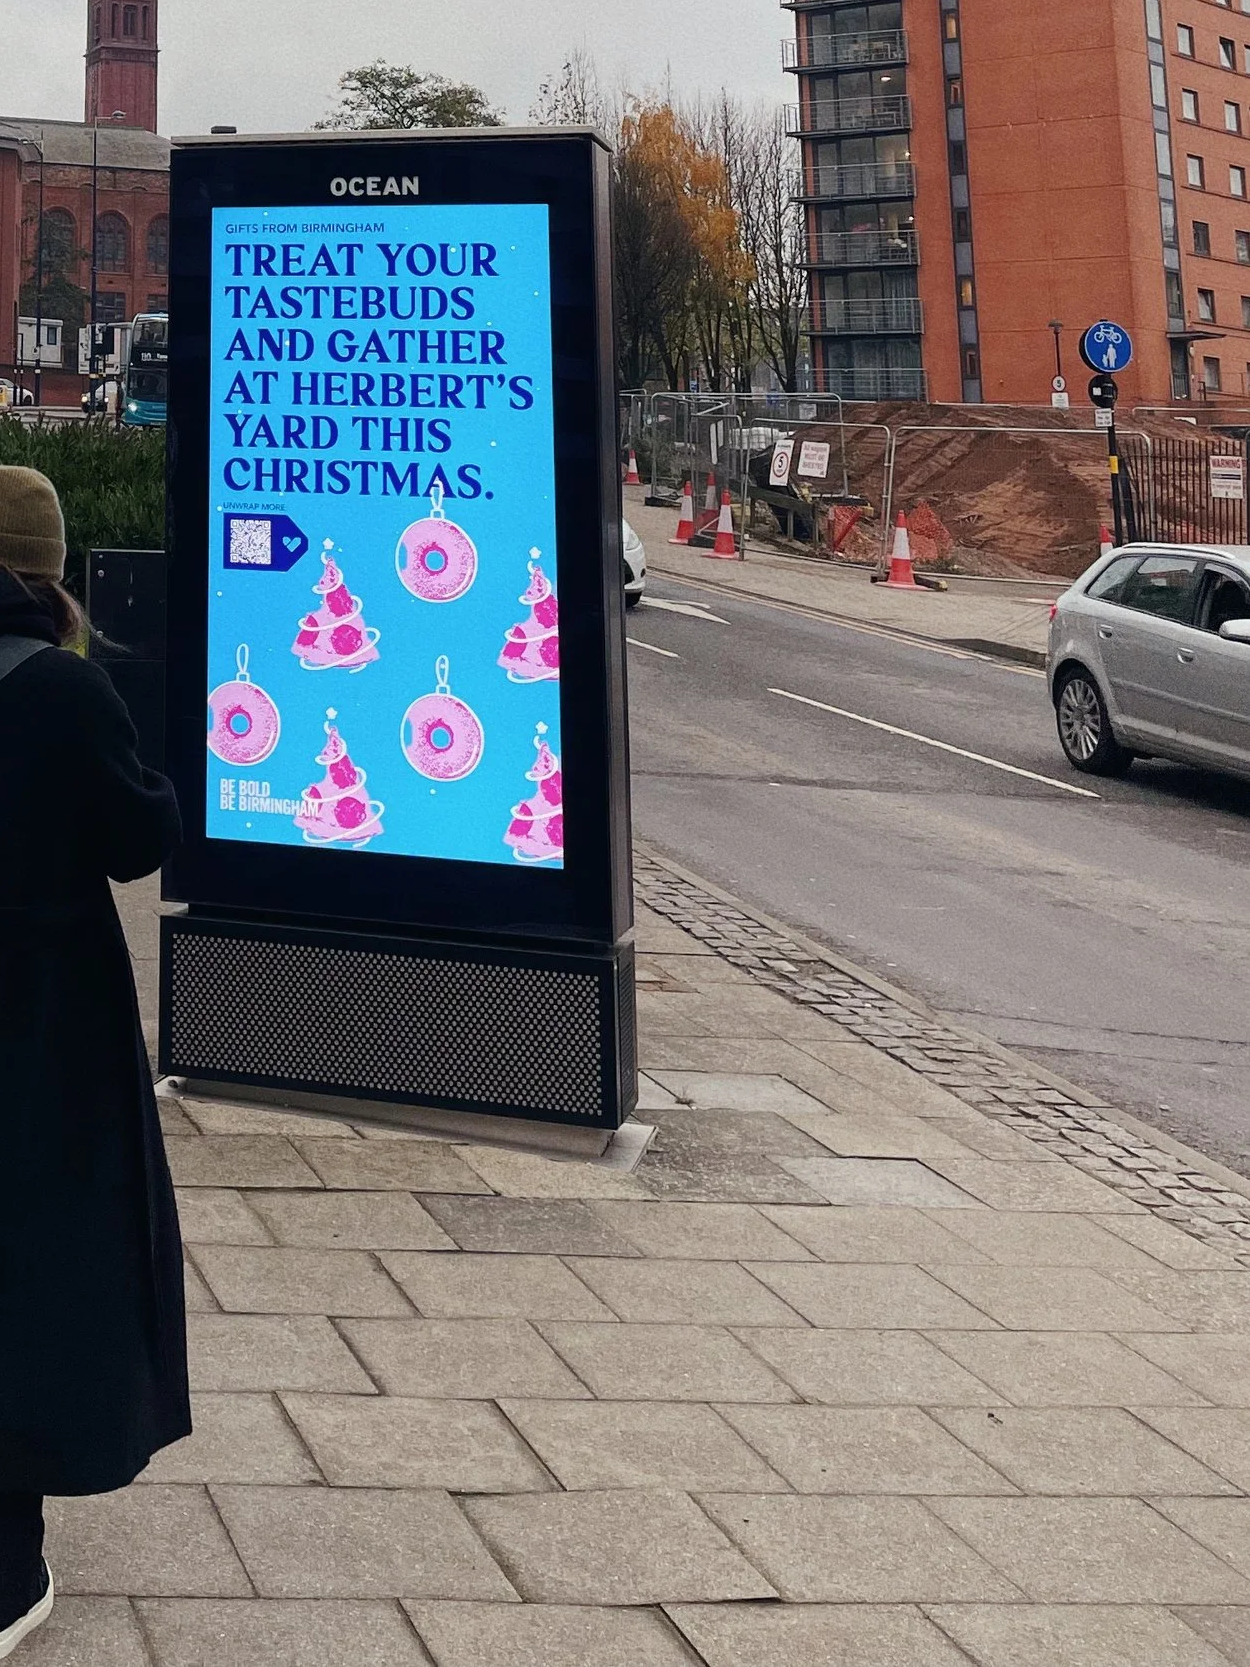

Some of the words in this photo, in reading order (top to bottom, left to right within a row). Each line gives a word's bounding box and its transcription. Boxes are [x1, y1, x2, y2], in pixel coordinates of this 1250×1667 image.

[330, 176, 420, 196] OCEAN
[225, 223, 259, 234] GIFTS
[262, 223, 297, 233] FROM
[301, 222, 385, 233] BIRMINGHAM
[225, 242, 364, 276] TREAT
[377, 242, 499, 277] YOUR
[224, 285, 475, 321] TASTEBUDS
[223, 327, 315, 362] AND
[327, 328, 508, 365] GATHER
[223, 370, 279, 404] AT
[292, 371, 534, 410] HERBERT'S
[1056, 379, 1062, 388] 5
[223, 413, 339, 449] YARD
[351, 416, 452, 453] THIS
[778, 456, 784, 468] 5
[1211, 458, 1241, 469] WARNING
[223, 457, 494, 501] CHRISTMAS.
[223, 502, 260, 511] UNWRAP
[261, 503, 286, 512] MORE
[220, 778, 236, 794] BE
[238, 779, 271, 797] BOLD
[220, 794, 236, 811] BE
[238, 796, 319, 817] BIRMINGHAM
